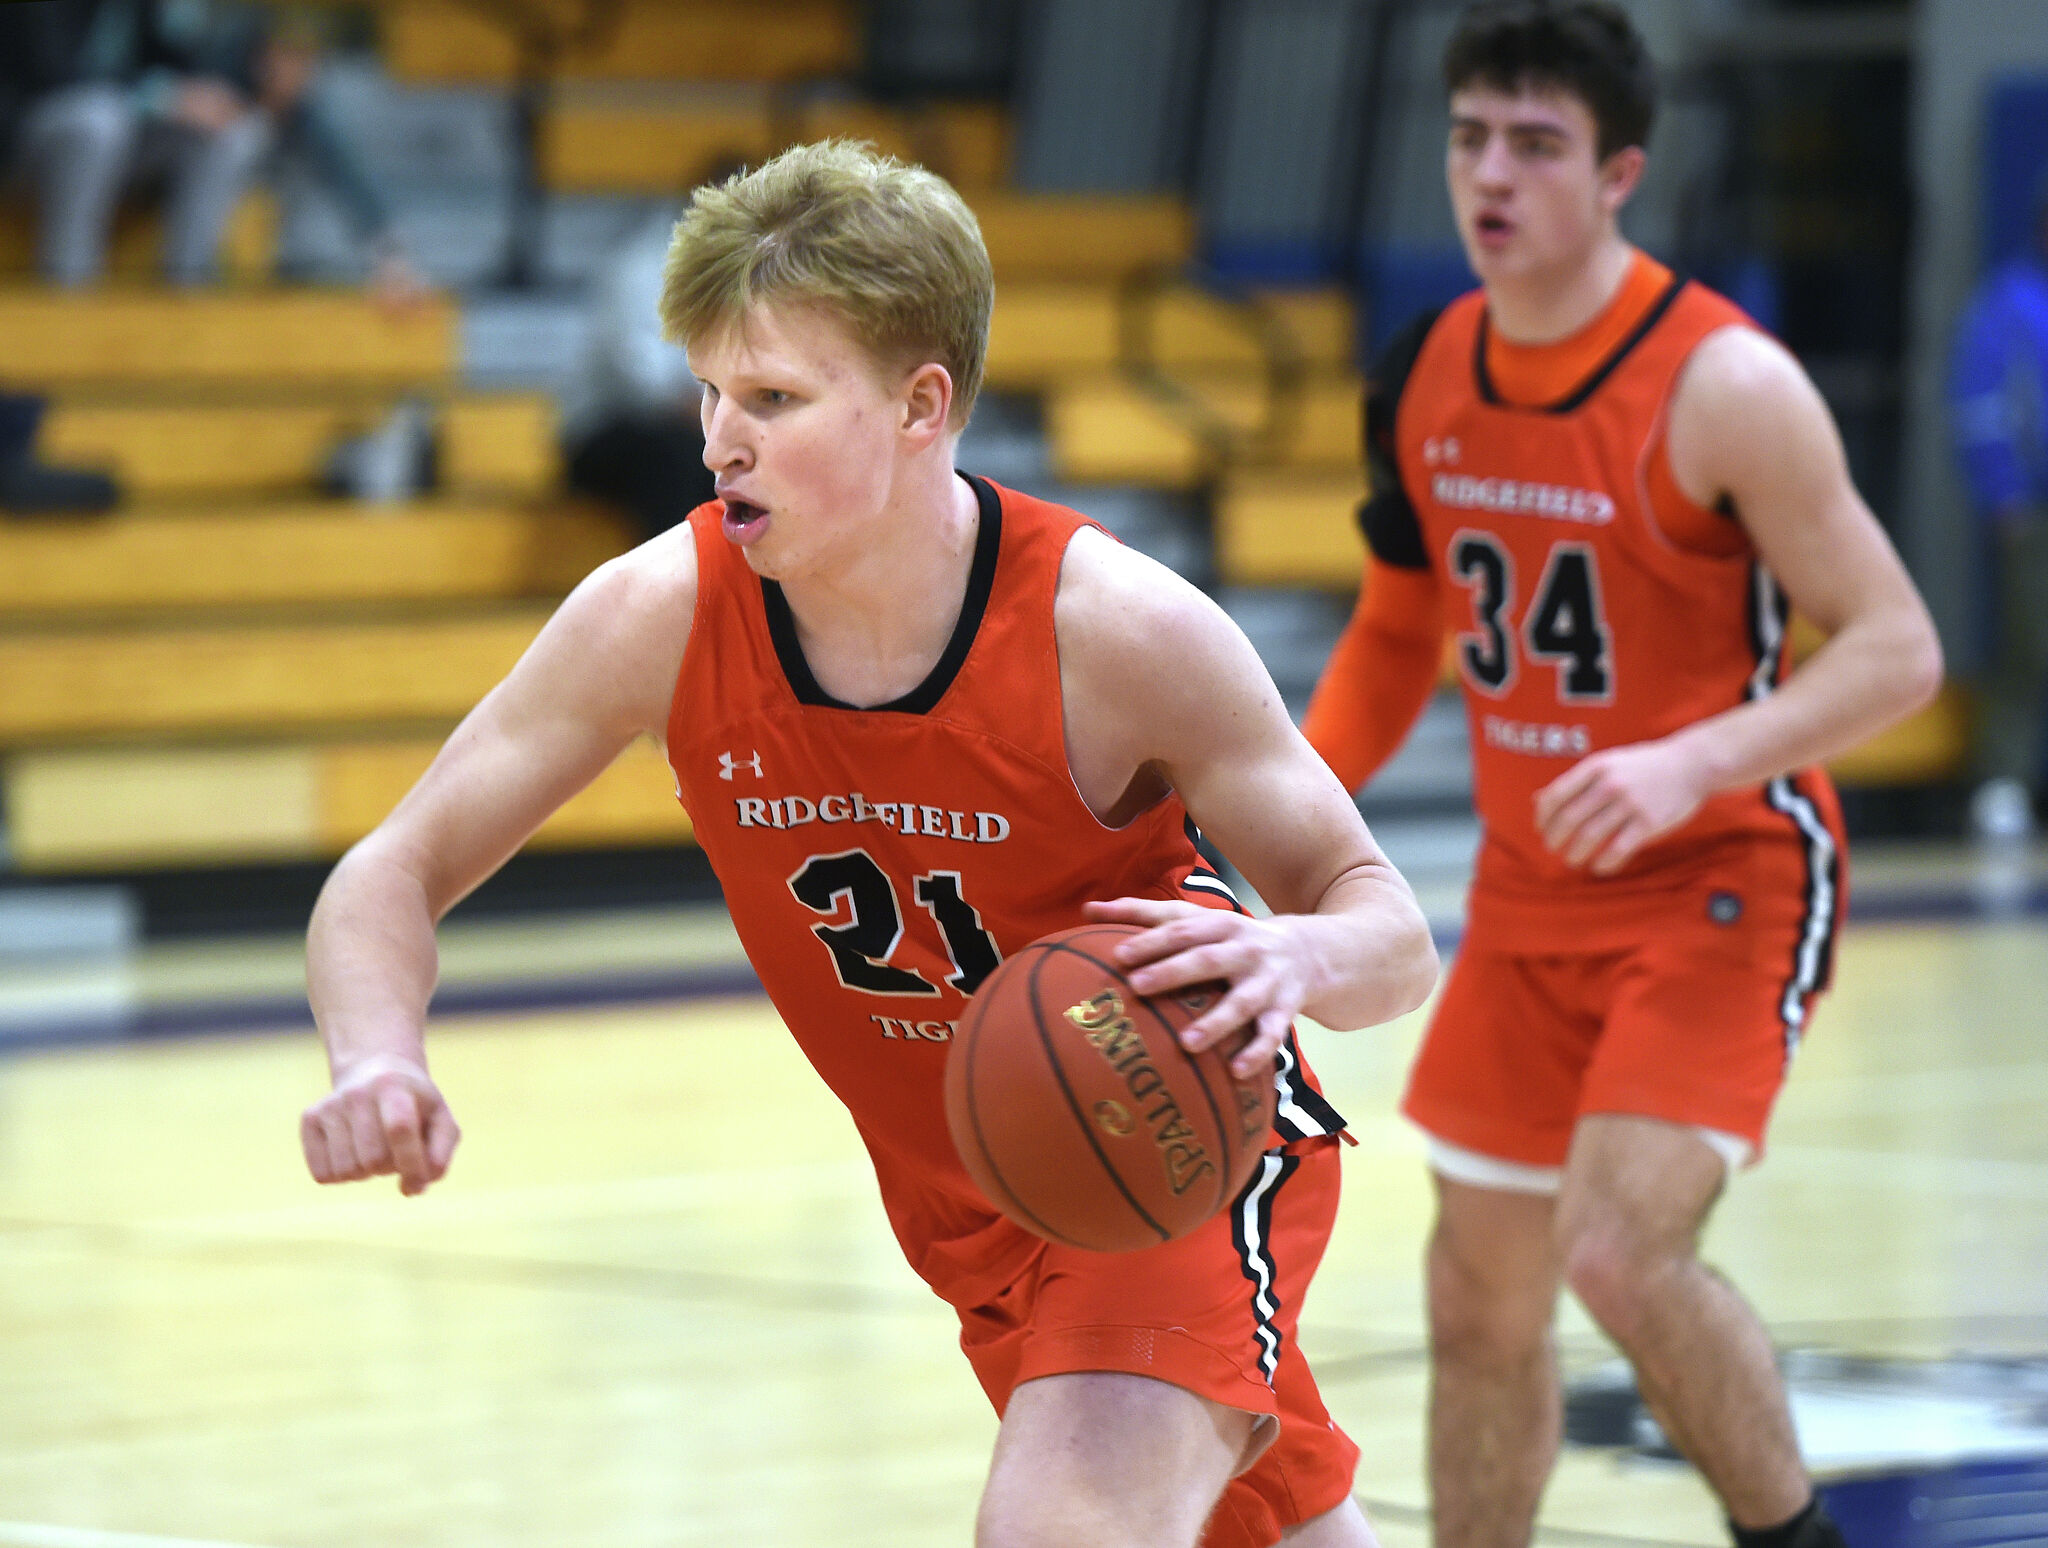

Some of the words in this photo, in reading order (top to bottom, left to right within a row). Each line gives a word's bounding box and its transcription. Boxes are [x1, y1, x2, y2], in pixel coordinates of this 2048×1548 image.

[1432, 473, 1615, 526] RIDGEFIELD
[1449, 528, 1616, 705] 34
[736, 792, 1011, 843] RIDGEFIELD
[786, 847, 1003, 999] 21
[1062, 988, 1215, 1196] SPALDING
